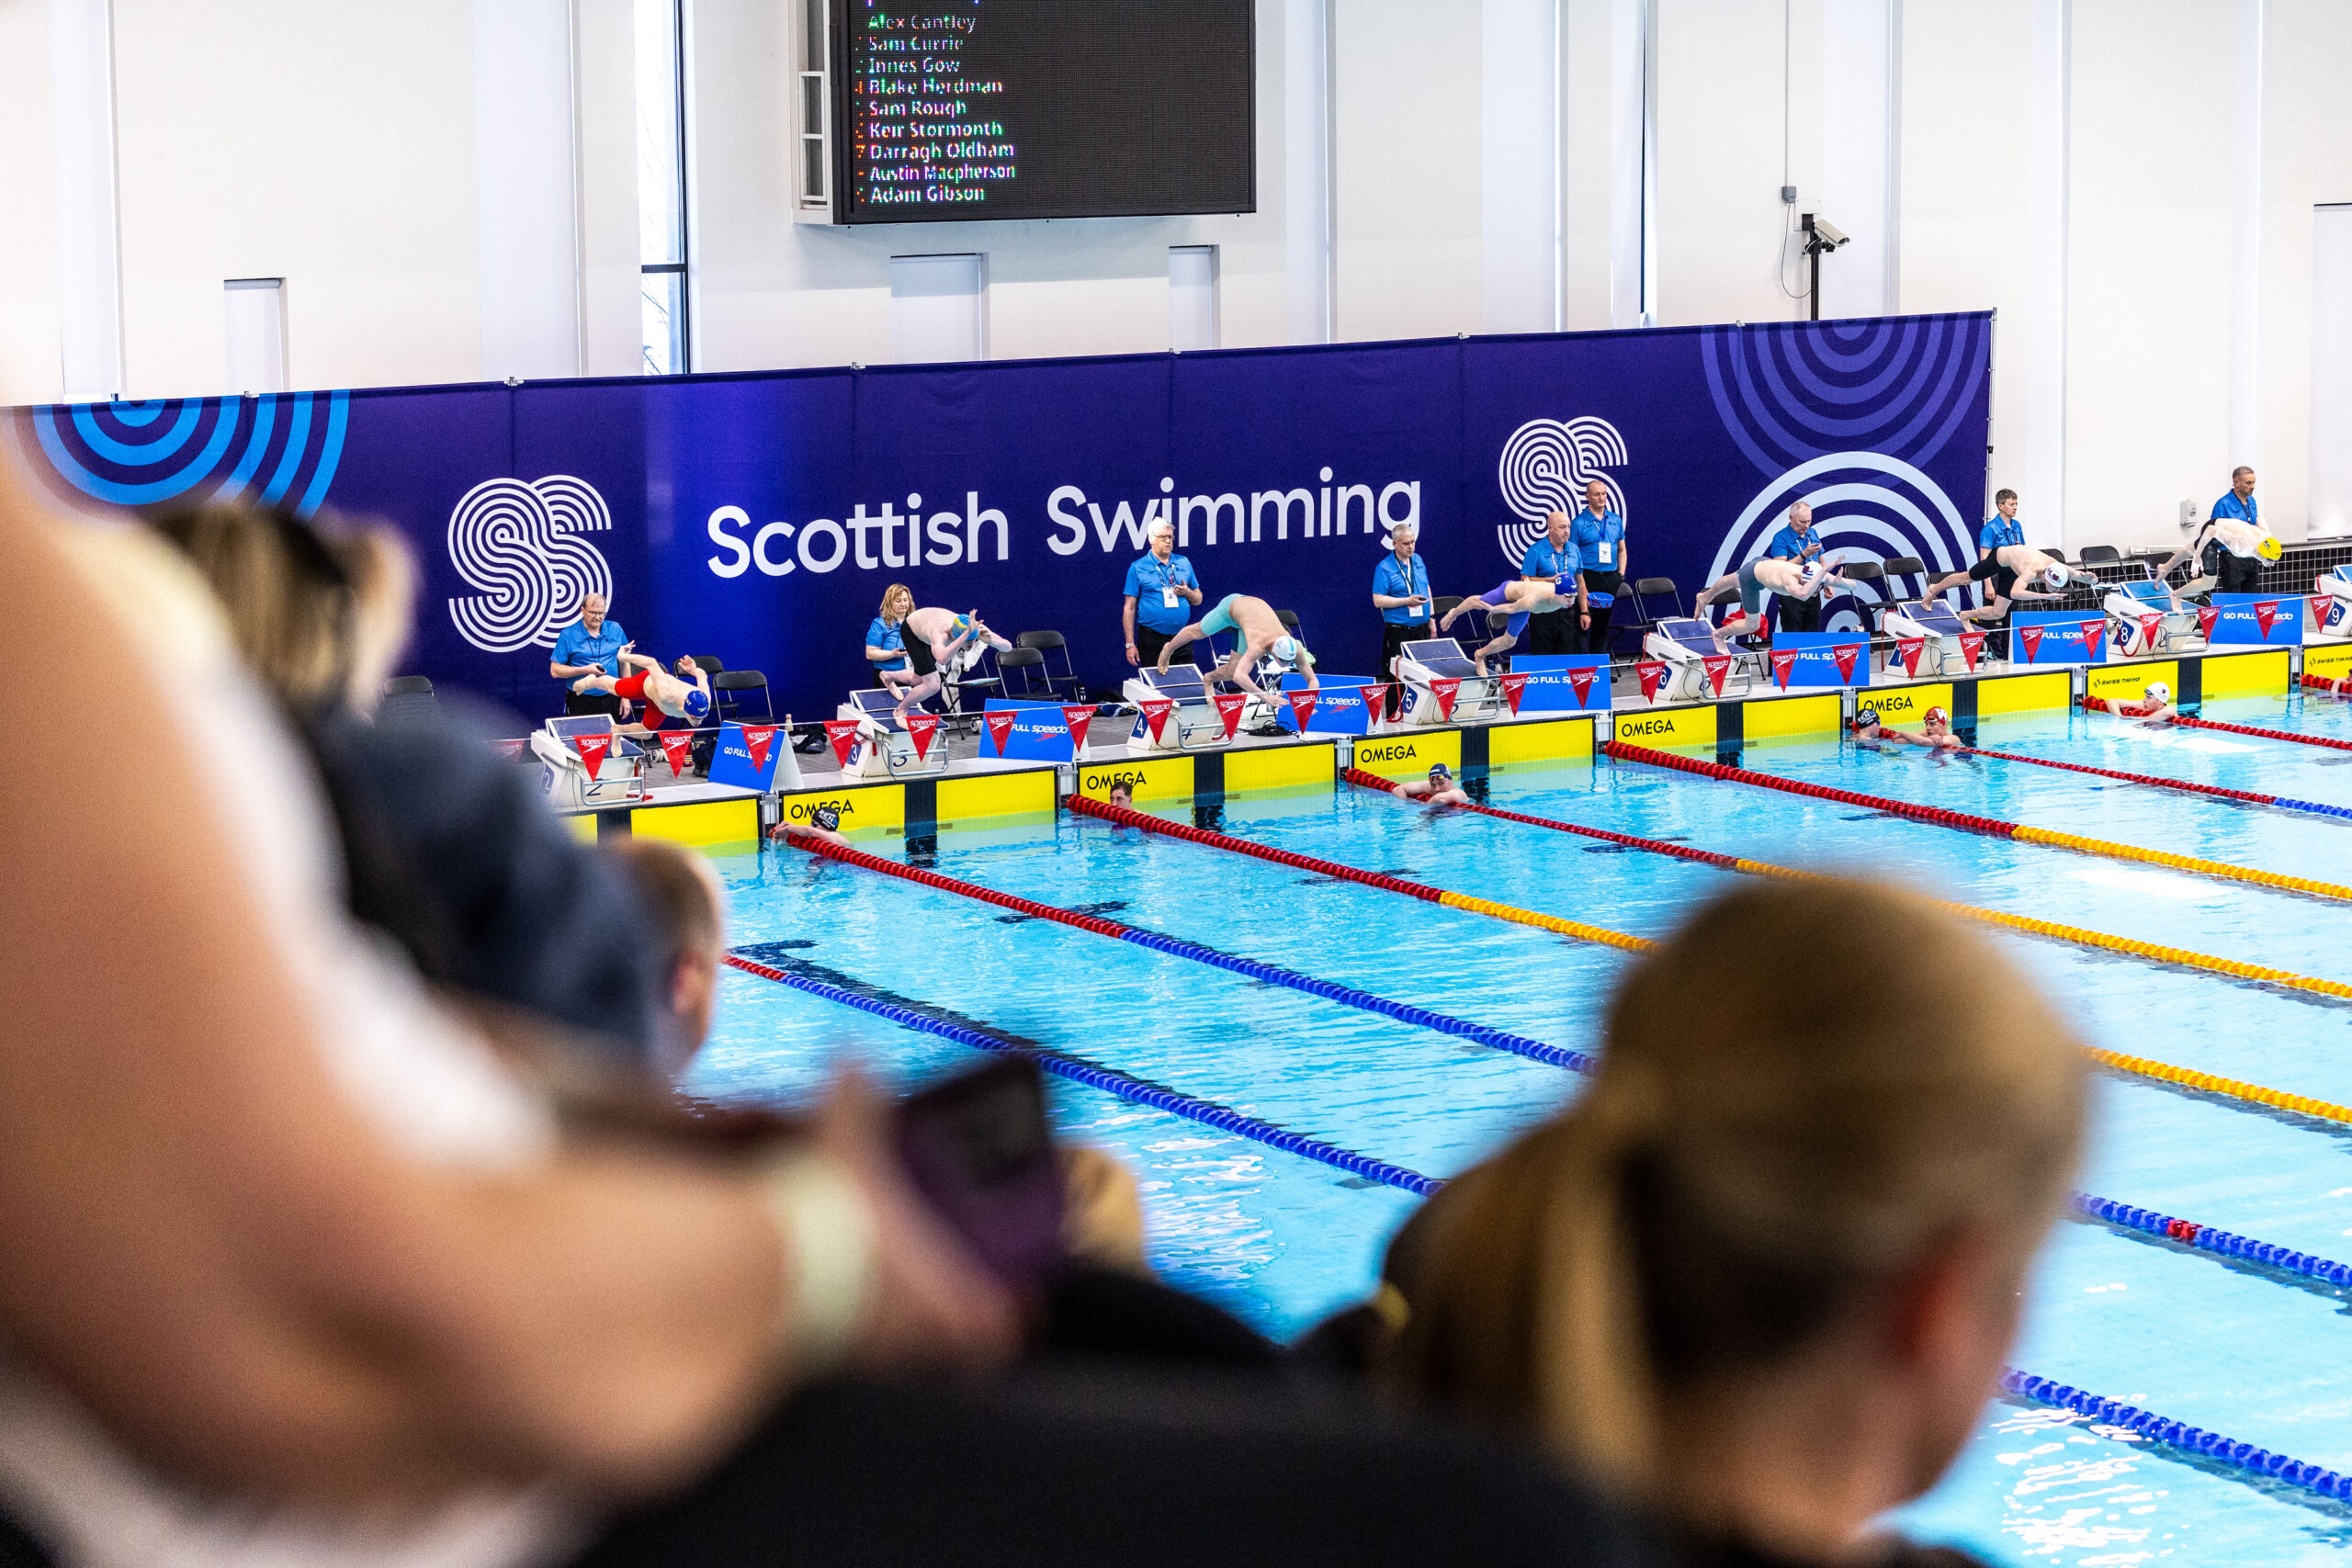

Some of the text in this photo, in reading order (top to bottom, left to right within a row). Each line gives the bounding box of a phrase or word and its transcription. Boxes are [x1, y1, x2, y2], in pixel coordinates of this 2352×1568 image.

[911, 15, 977, 34] Cantley
[869, 37, 905, 51] Sam
[869, 57, 960, 73] Innes Gow
[869, 78, 917, 95] Blake
[923, 78, 1003, 95] Herdman
[869, 99, 967, 118] Sam Rough
[870, 121, 1003, 138] Keir Stormonth
[870, 141, 942, 163] Darragh
[946, 141, 1014, 159] Oldham
[870, 163, 1016, 184] Austin Macpherson
[870, 184, 985, 203] Adam Gibson
[707, 466, 1420, 578] Scottish Swimming
[2332, 608, 2339, 623] 9
[2121, 627, 2128, 642] 8
[1836, 648, 1858, 656] speedo
[1641, 665, 1662, 673] speedo
[1660, 670, 1667, 685] 6
[1435, 682, 1458, 691] speedo
[1146, 701, 1170, 710] speedo
[1219, 699, 1244, 708] speedo
[1293, 694, 1316, 703] speedo
[1325, 697, 1361, 706] speedo
[1406, 693, 1413, 710] 5
[1864, 695, 1914, 712] OMEGA
[989, 716, 1013, 724] speedo
[1068, 710, 1093, 718] speedo
[831, 725, 856, 733] speedo
[910, 719, 936, 728] speedo
[1012, 724, 1068, 734] FULL speedo
[1136, 717, 1144, 735] 4
[1622, 718, 1675, 737] OMEGA
[664, 735, 691, 743] speedo
[747, 730, 774, 739] speedo
[581, 739, 608, 748] speedo
[724, 747, 732, 755] GO
[733, 748, 746, 757] FULL
[851, 744, 857, 761] 3
[1361, 744, 1417, 763] OMEGA
[544, 772, 550, 790] 2
